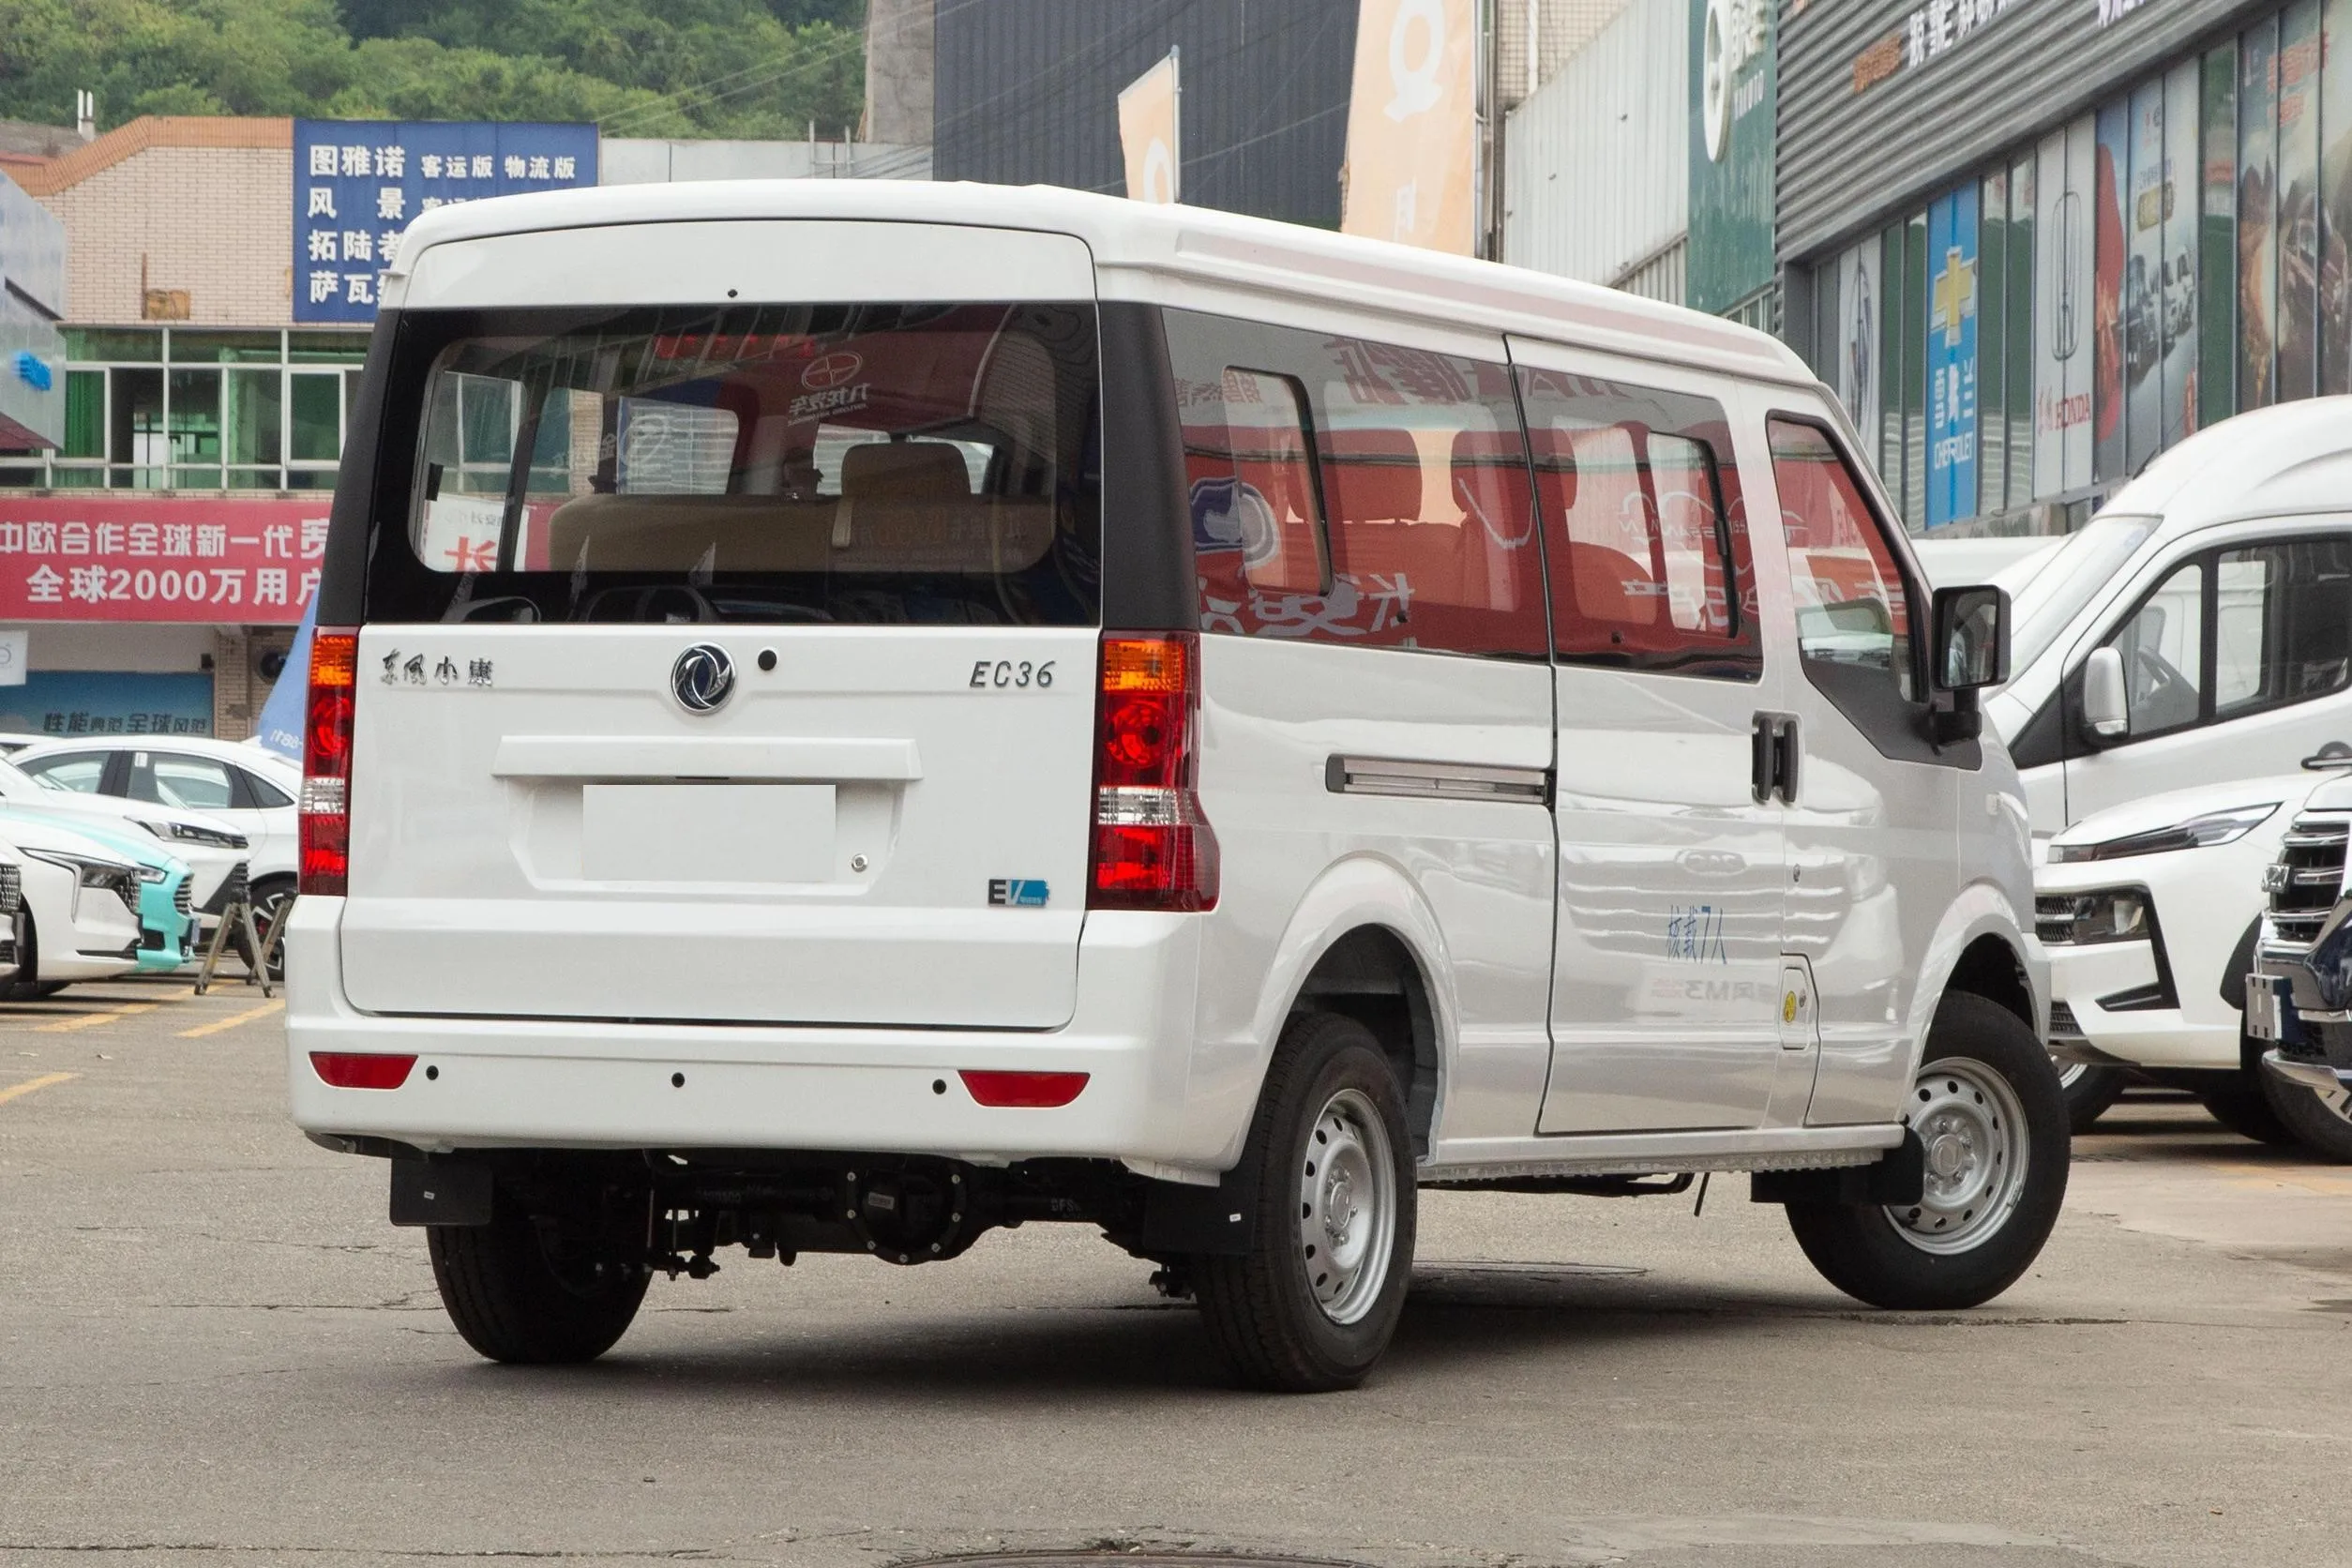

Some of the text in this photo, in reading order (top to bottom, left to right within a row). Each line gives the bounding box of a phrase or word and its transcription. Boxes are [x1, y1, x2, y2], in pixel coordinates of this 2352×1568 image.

[309, 145, 576, 179] 图雅诺 客运版 物流版
[308, 229, 404, 262] 拓陆者
[309, 270, 385, 305] 萨瓦
[381, 648, 493, 687] 东风小康
[970, 661, 1056, 687] EC36
